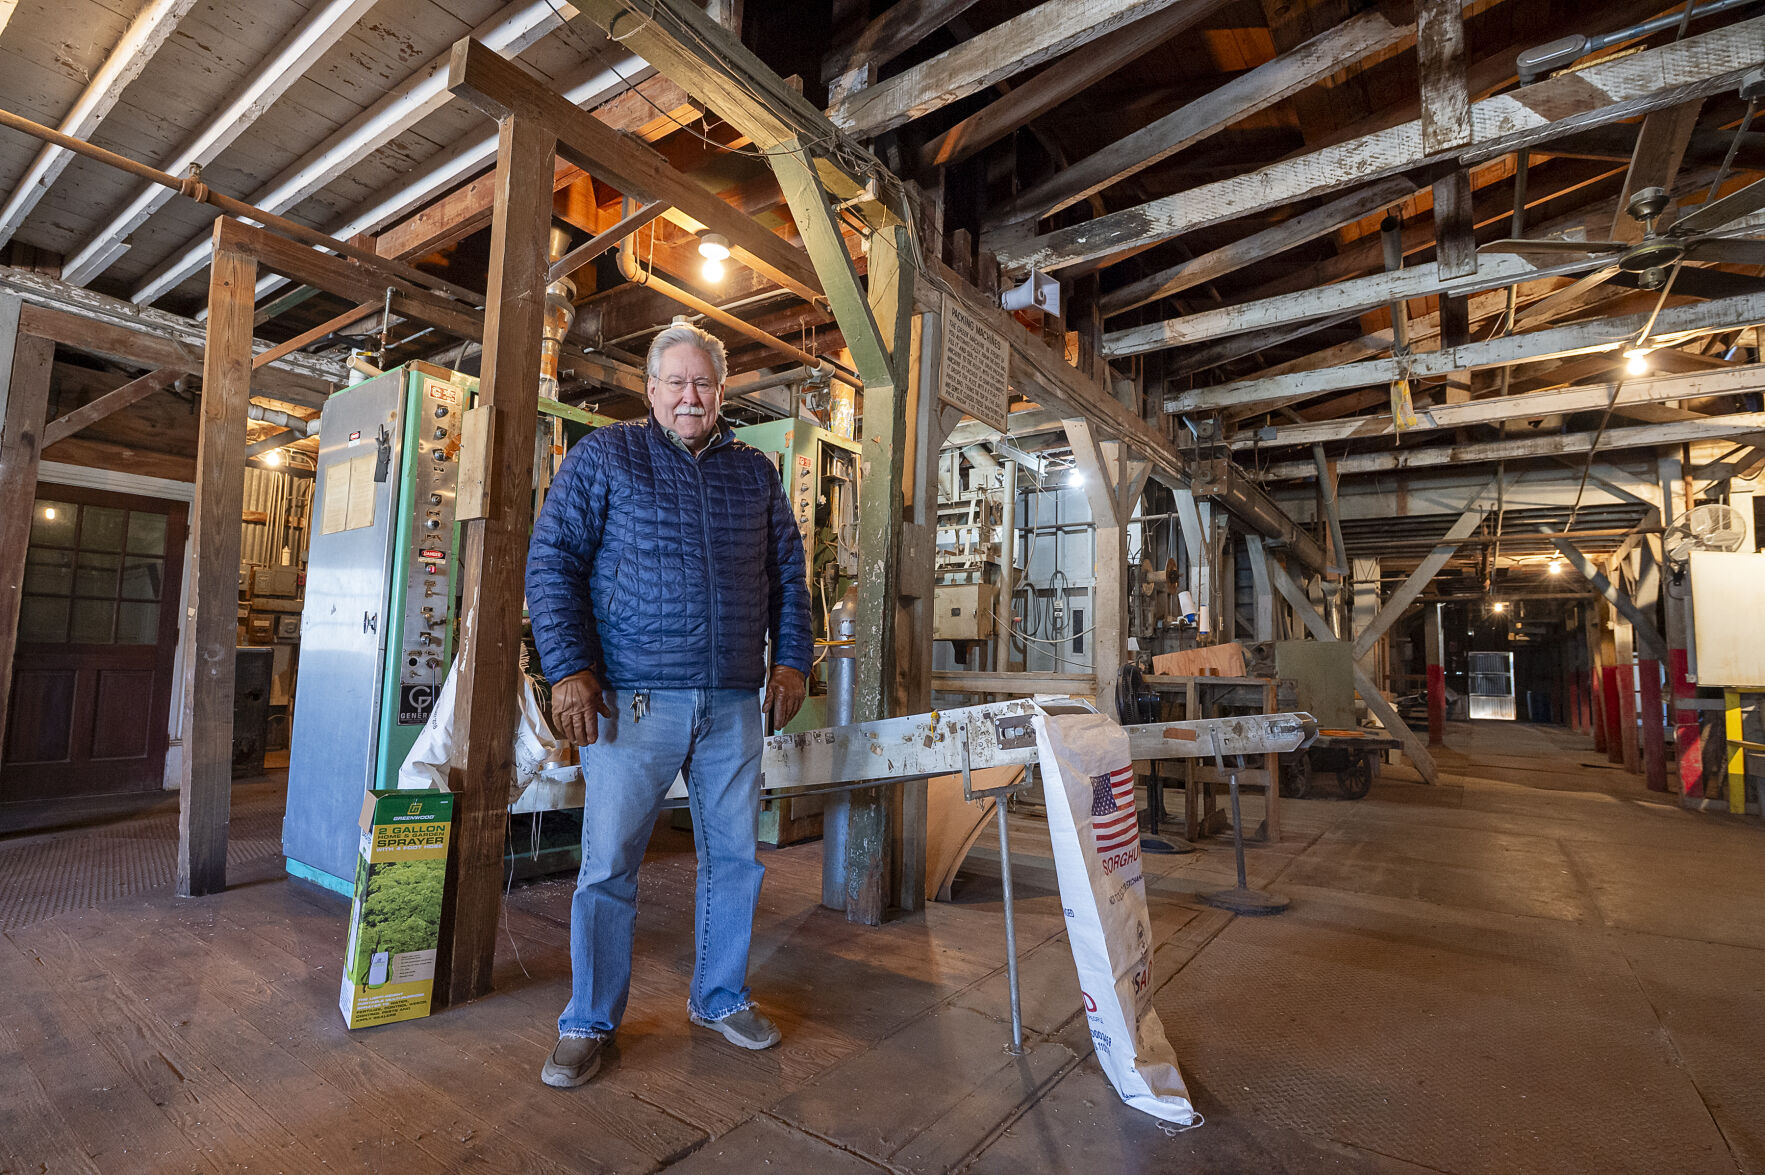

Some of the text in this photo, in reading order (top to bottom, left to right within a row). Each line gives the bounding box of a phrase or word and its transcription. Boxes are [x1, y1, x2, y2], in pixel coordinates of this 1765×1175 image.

[952, 307, 1001, 350] PACKING MACHINES
[957, 325, 968, 339] GREEN
[379, 825, 446, 835] 2 GALLON
[377, 837, 444, 848] SPRAYER
